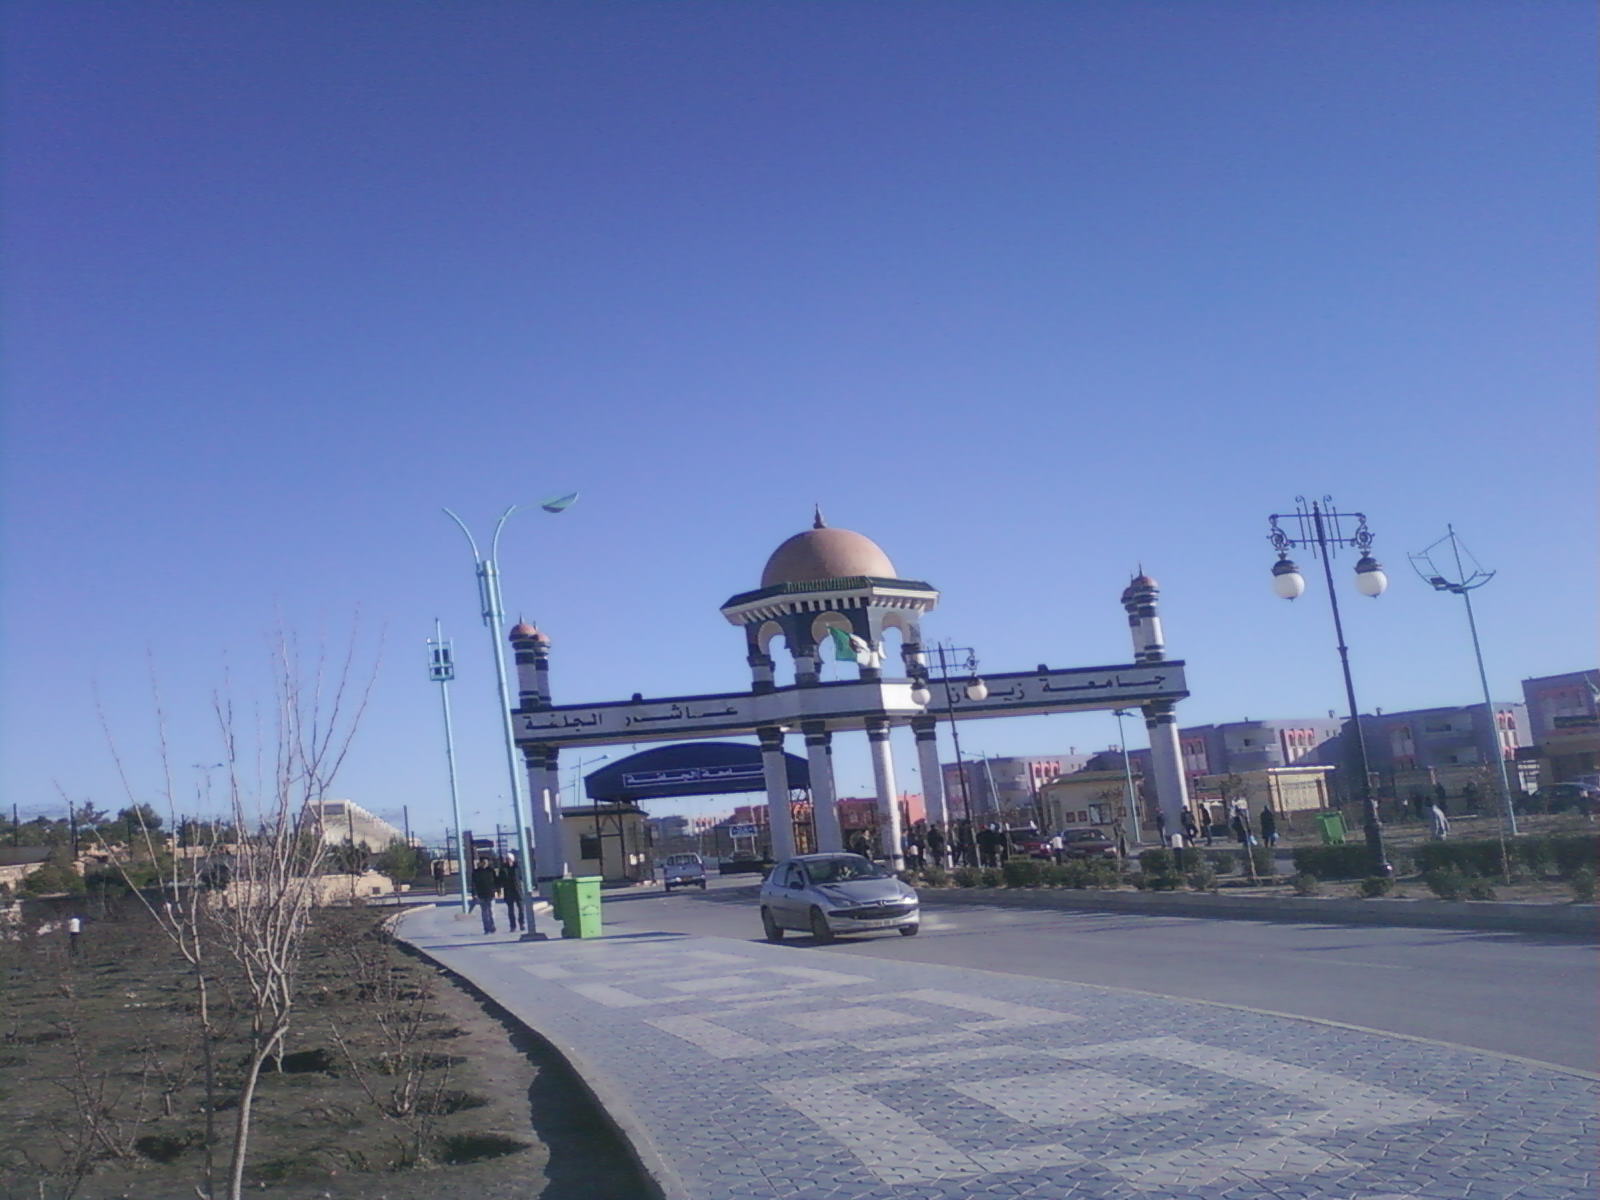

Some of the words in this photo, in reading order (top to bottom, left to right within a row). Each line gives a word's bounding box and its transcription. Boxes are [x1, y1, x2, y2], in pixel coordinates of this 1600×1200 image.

[1039, 675, 1166, 692] جامعة
[523, 713, 602, 732] الجلفة
[625, 704, 738, 727] عاشور
